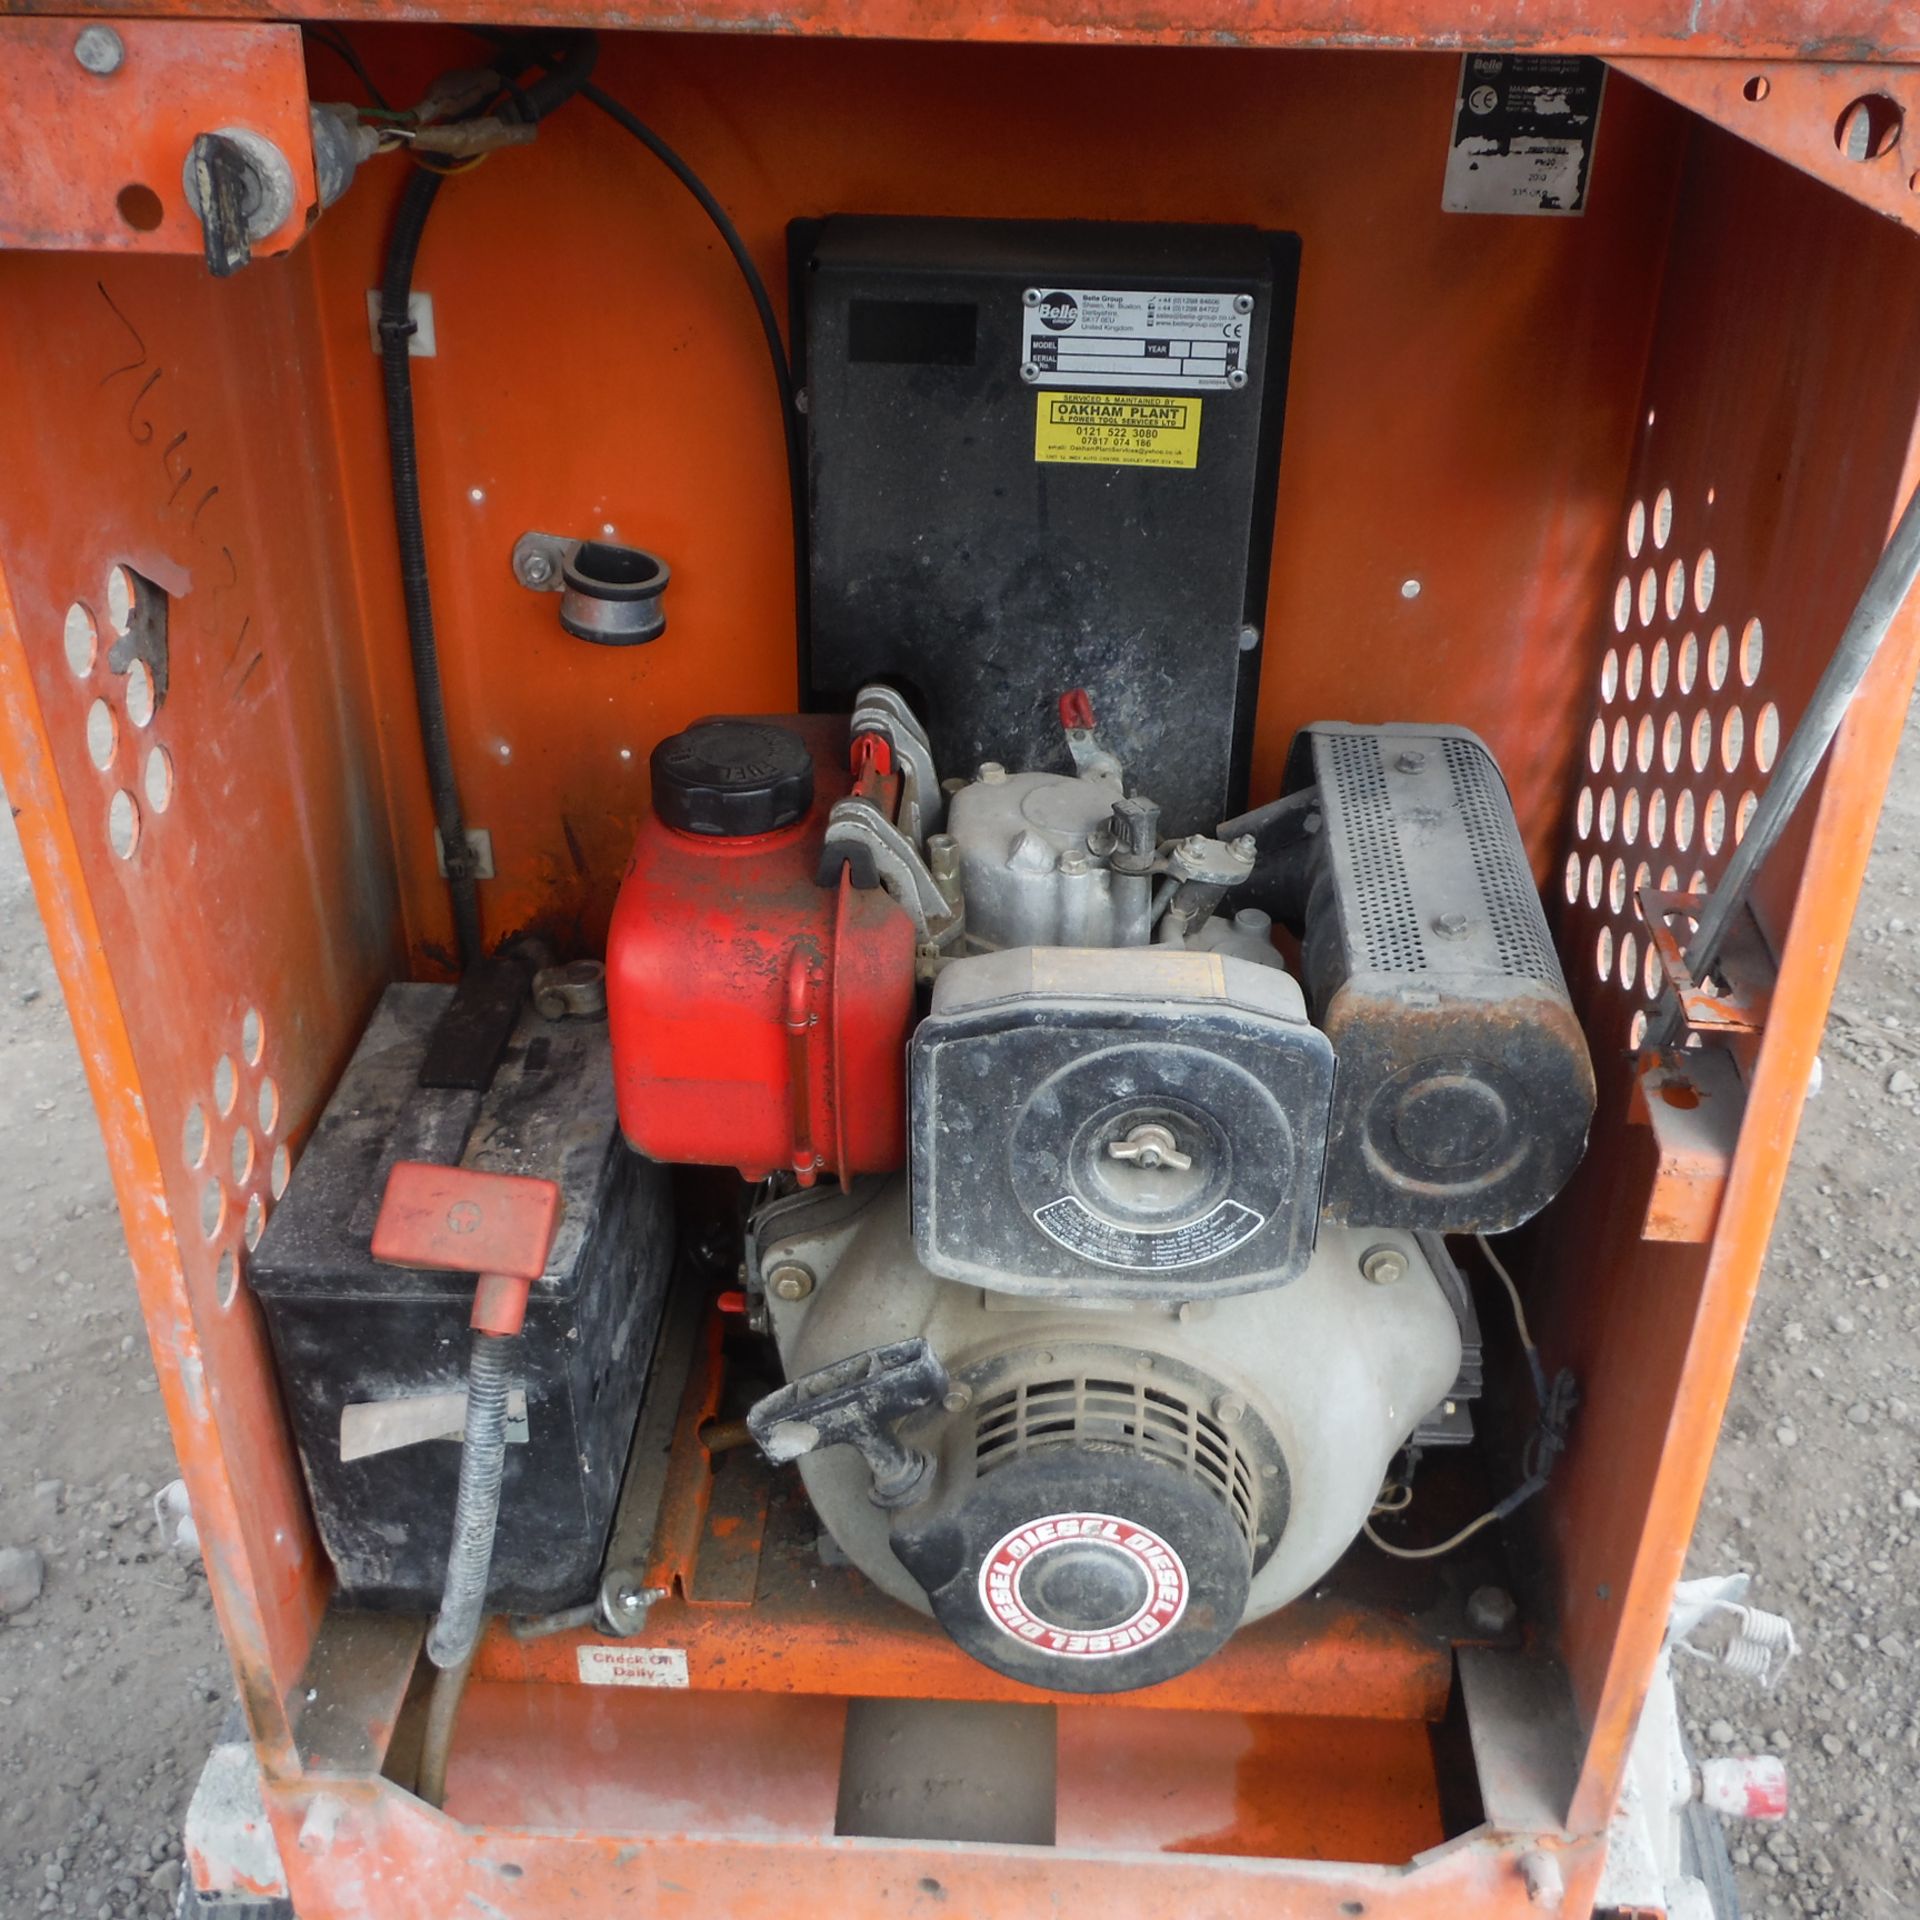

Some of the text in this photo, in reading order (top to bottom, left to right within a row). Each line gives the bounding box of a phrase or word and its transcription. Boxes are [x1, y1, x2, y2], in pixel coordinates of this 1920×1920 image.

[1474, 58, 1502, 69] Belle
[1101, 295, 1123, 303] Group
[1039, 303, 1078, 318] Belle
[1104, 324, 1133, 332] Kingdom
[1032, 341, 1057, 349] MODEL
[1147, 345, 1167, 353] YEAR
[1032, 354, 1057, 362] SERIAL
[1063, 394, 1102, 402] SERVICED
[1114, 396, 1161, 404] MAINTAINED
[1058, 404, 1180, 419] OAKHAM PLANT
[1121, 418, 1159, 426] SERVICES
[1076, 426, 1158, 439] 0121 522 3080
[1081, 436, 1152, 447] 07817 074 186
[989, 1519, 1179, 1652] DIESEL DIESEL DIESEL DIESEL
[592, 1652, 644, 1665] Check
[613, 1666, 656, 1679] Daily
